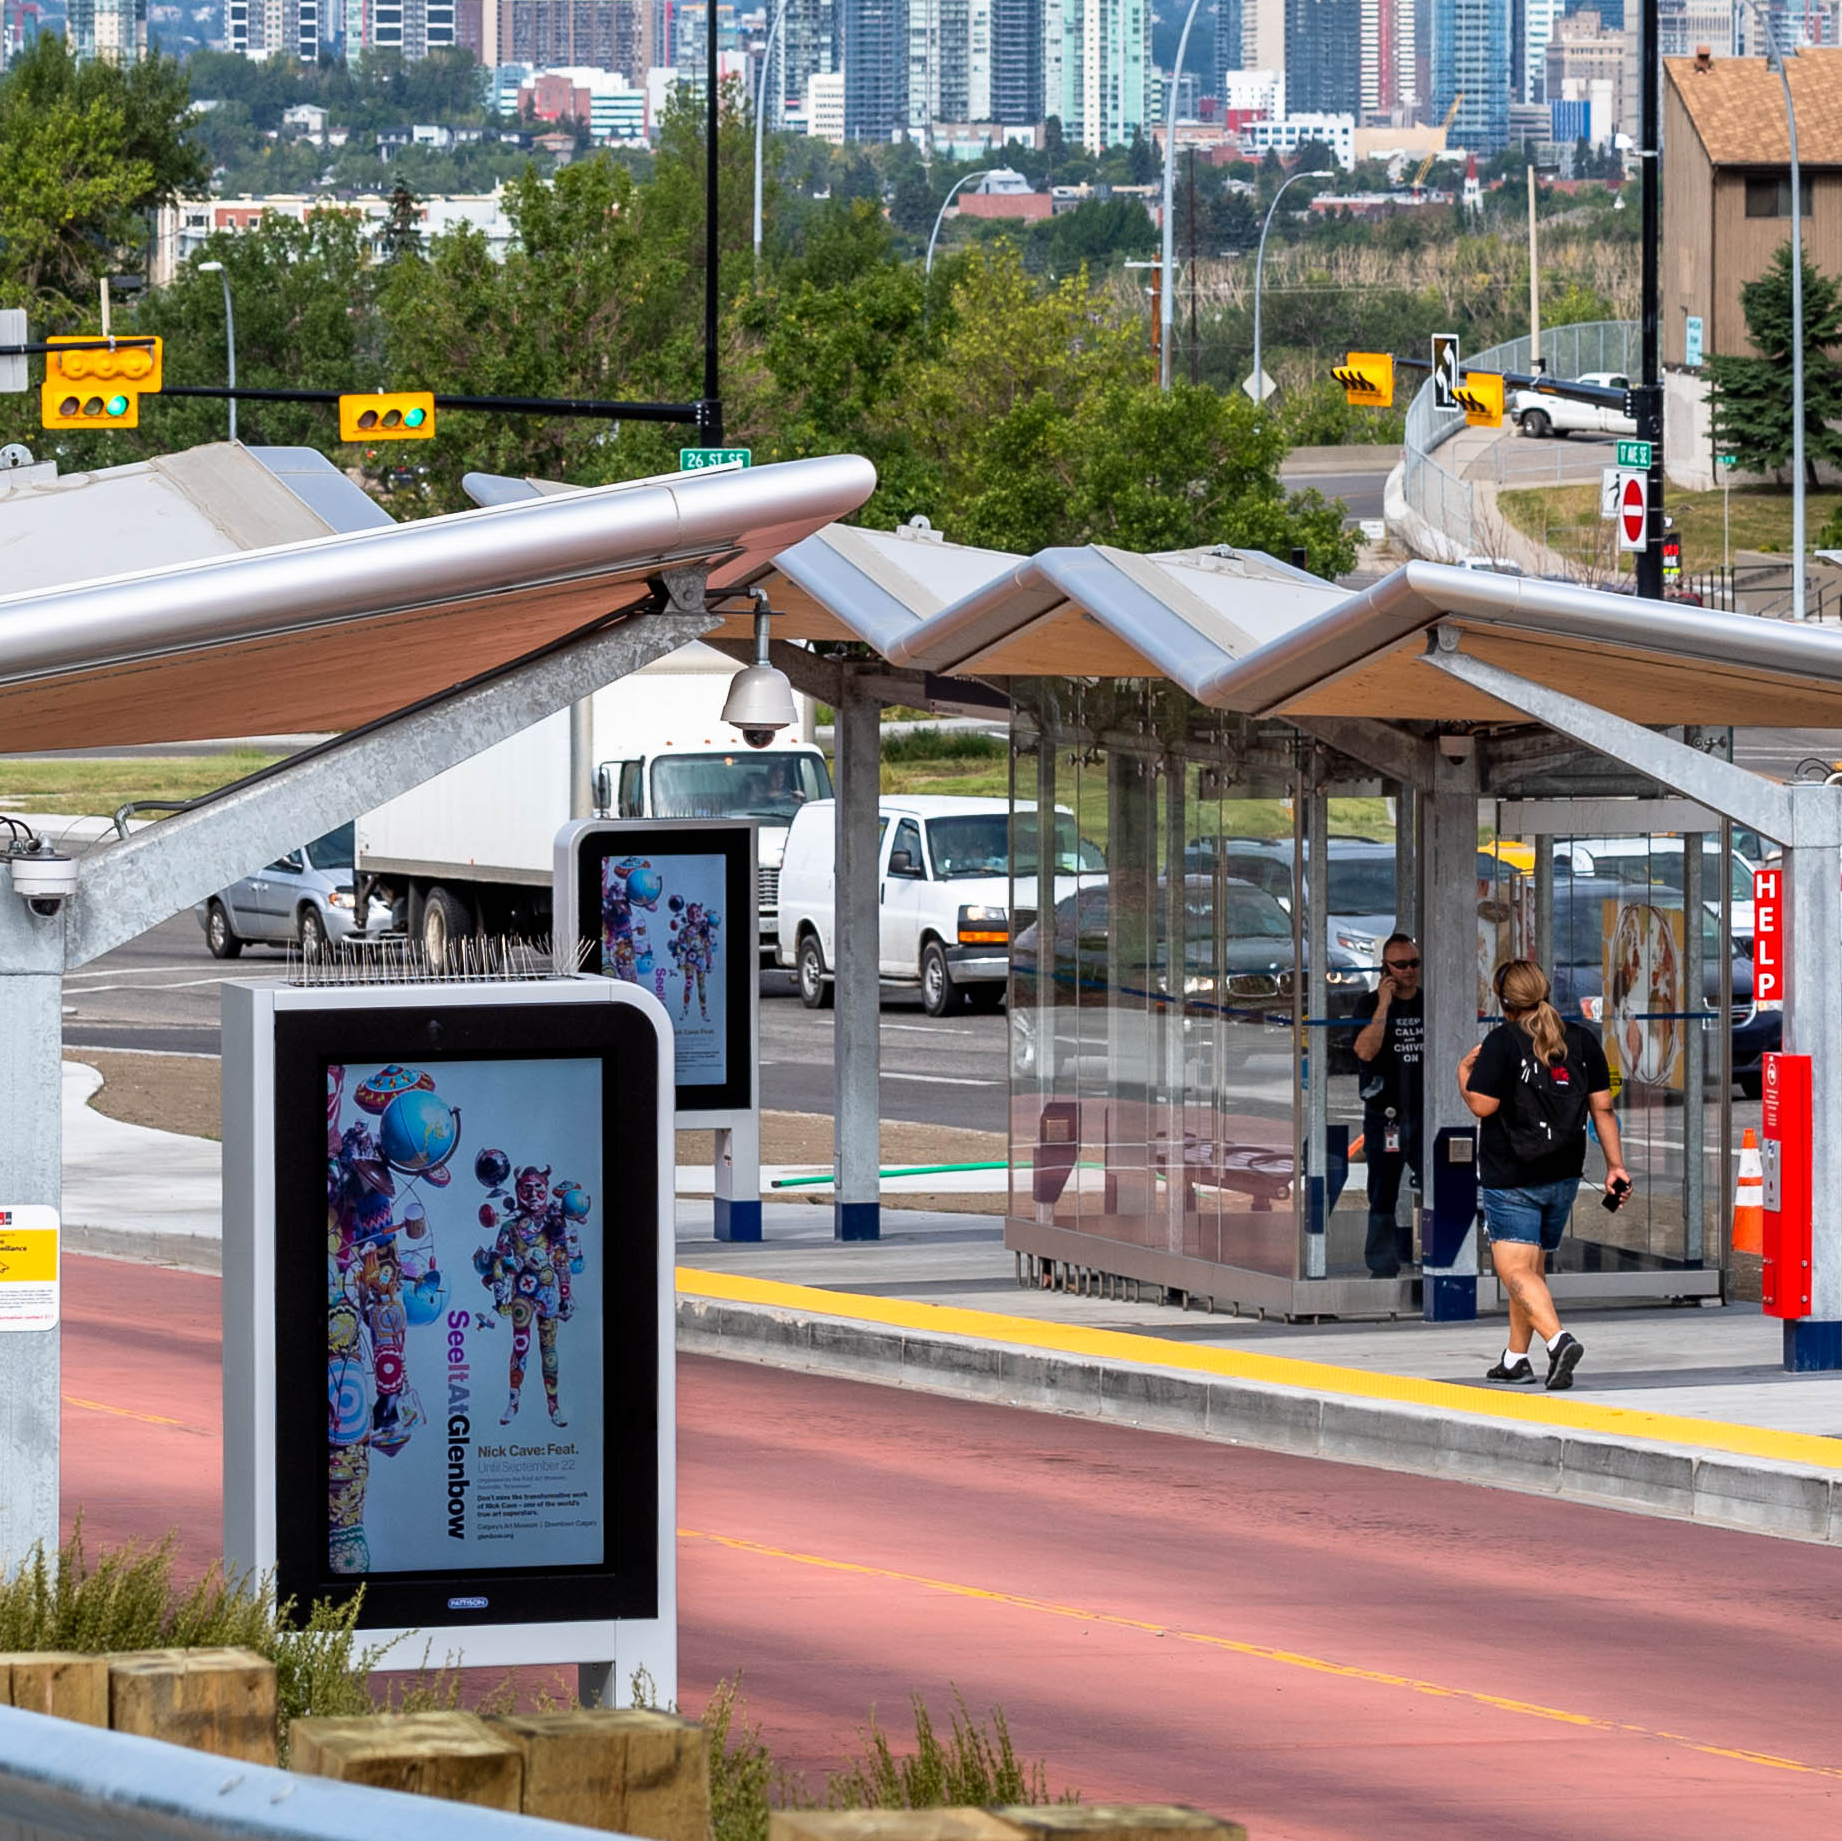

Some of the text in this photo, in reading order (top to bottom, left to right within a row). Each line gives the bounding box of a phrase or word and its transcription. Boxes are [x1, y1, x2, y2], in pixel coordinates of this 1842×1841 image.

[687, 453, 704, 469] 26
[709, 452, 723, 465] ST
[1756, 873, 1776, 998] HELP
[1395, 1017, 1421, 1026] KEEP
[1394, 1026, 1424, 1037] CALM
[1403, 1054, 1419, 1063] ON
[477, 1443, 580, 1458] Nick Cave: Feat.
[478, 1459, 576, 1474] Until September 22
[523, 1492, 571, 1500] transformative
[502, 1510, 538, 1518] superstars.
